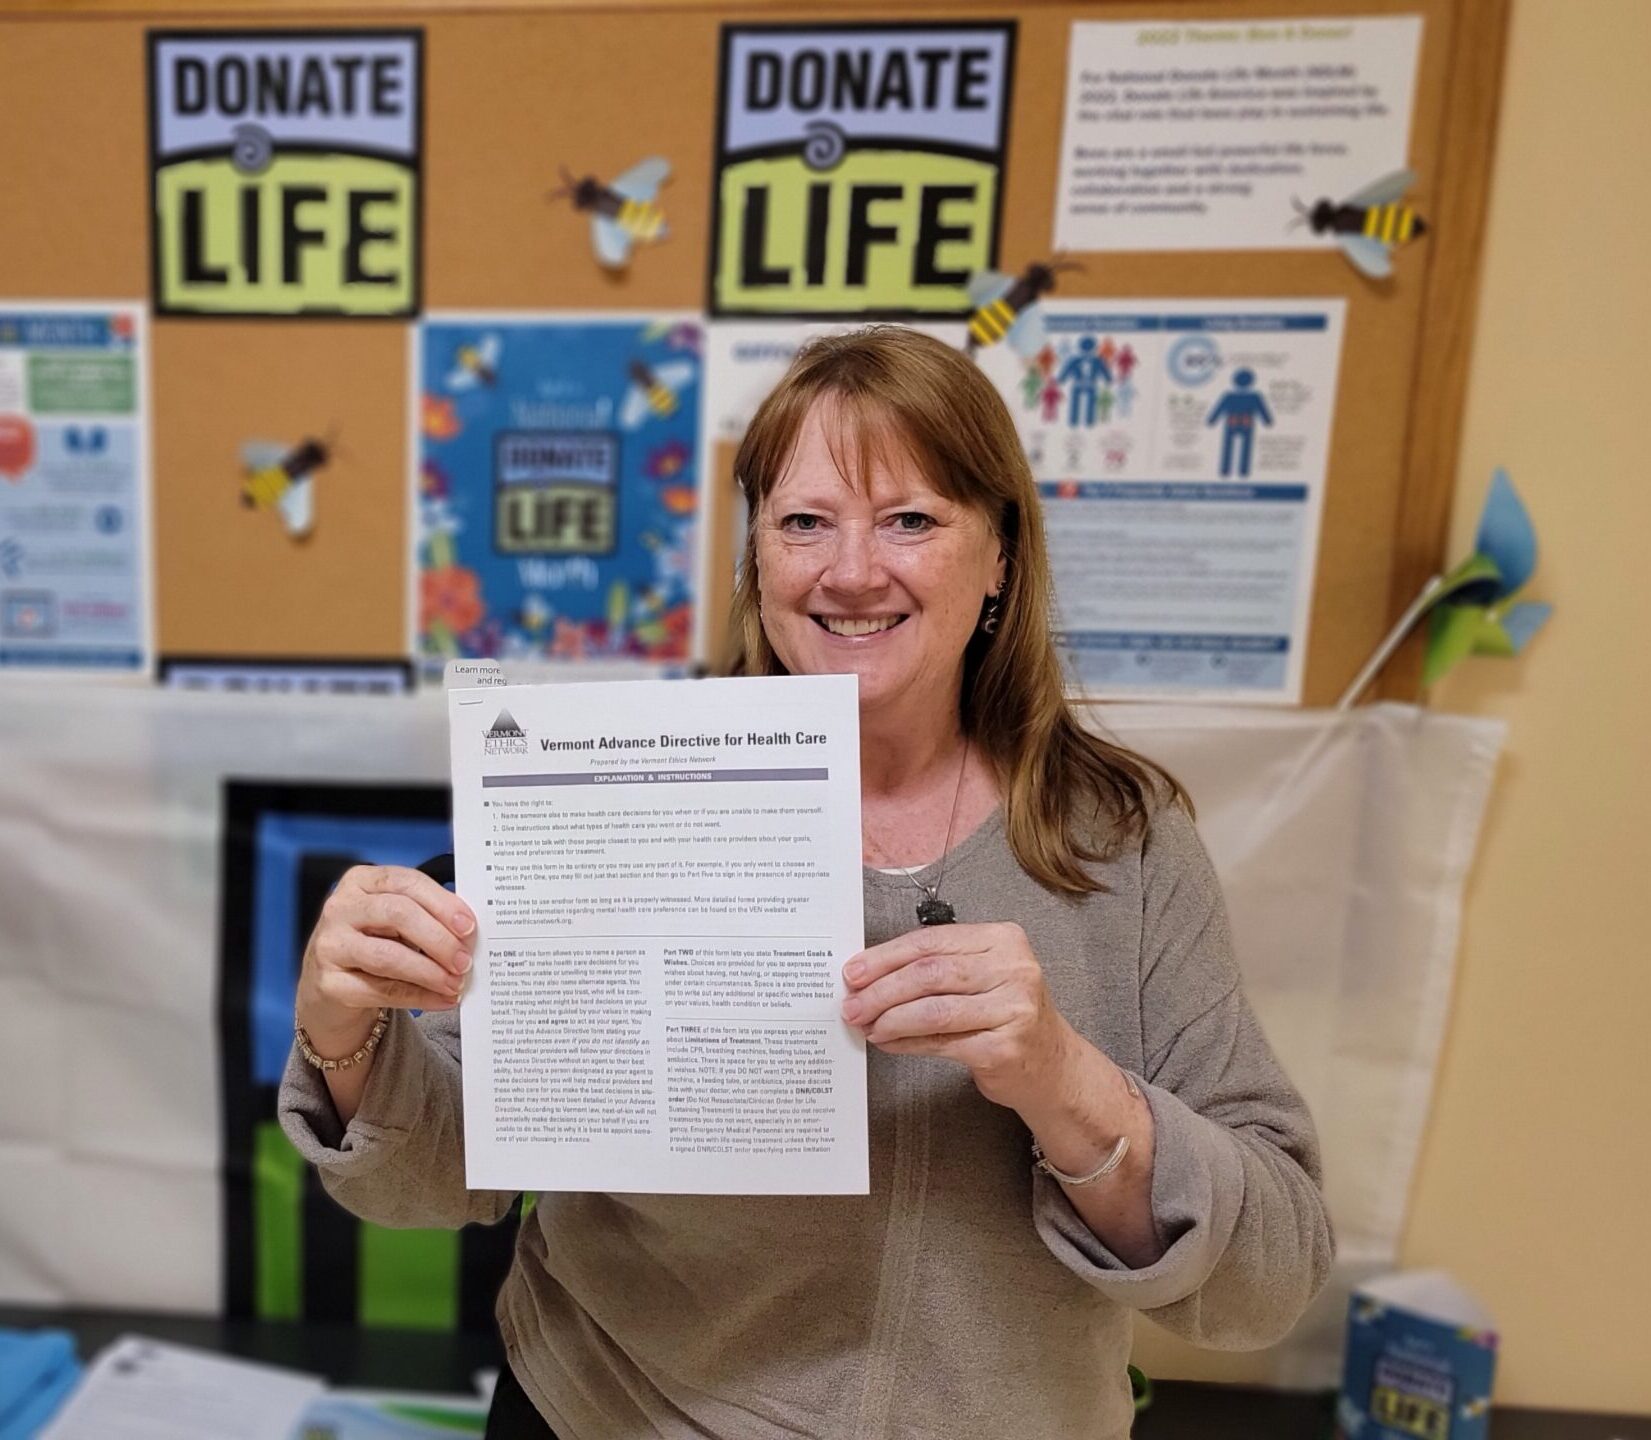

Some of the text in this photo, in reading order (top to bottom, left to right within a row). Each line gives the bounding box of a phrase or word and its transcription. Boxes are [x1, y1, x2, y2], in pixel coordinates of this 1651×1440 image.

[745, 47, 991, 112] DONATE
[174, 55, 402, 118] DONATE
[182, 186, 399, 284] LIFE
[740, 182, 978, 287] LIFE
[507, 497, 603, 542] LIFE
[454, 665, 478, 674] Learn
[477, 676, 492, 685] and
[482, 728, 528, 738] VERMONT
[485, 738, 528, 748] ETHICS
[540, 730, 828, 752] Vermont Advance Directive for Health Care
[484, 746, 528, 756] NETWORK
[589, 758, 618, 766] Prepared
[594, 772, 712, 783] EXPLANATION & INSTRUCTIONS
